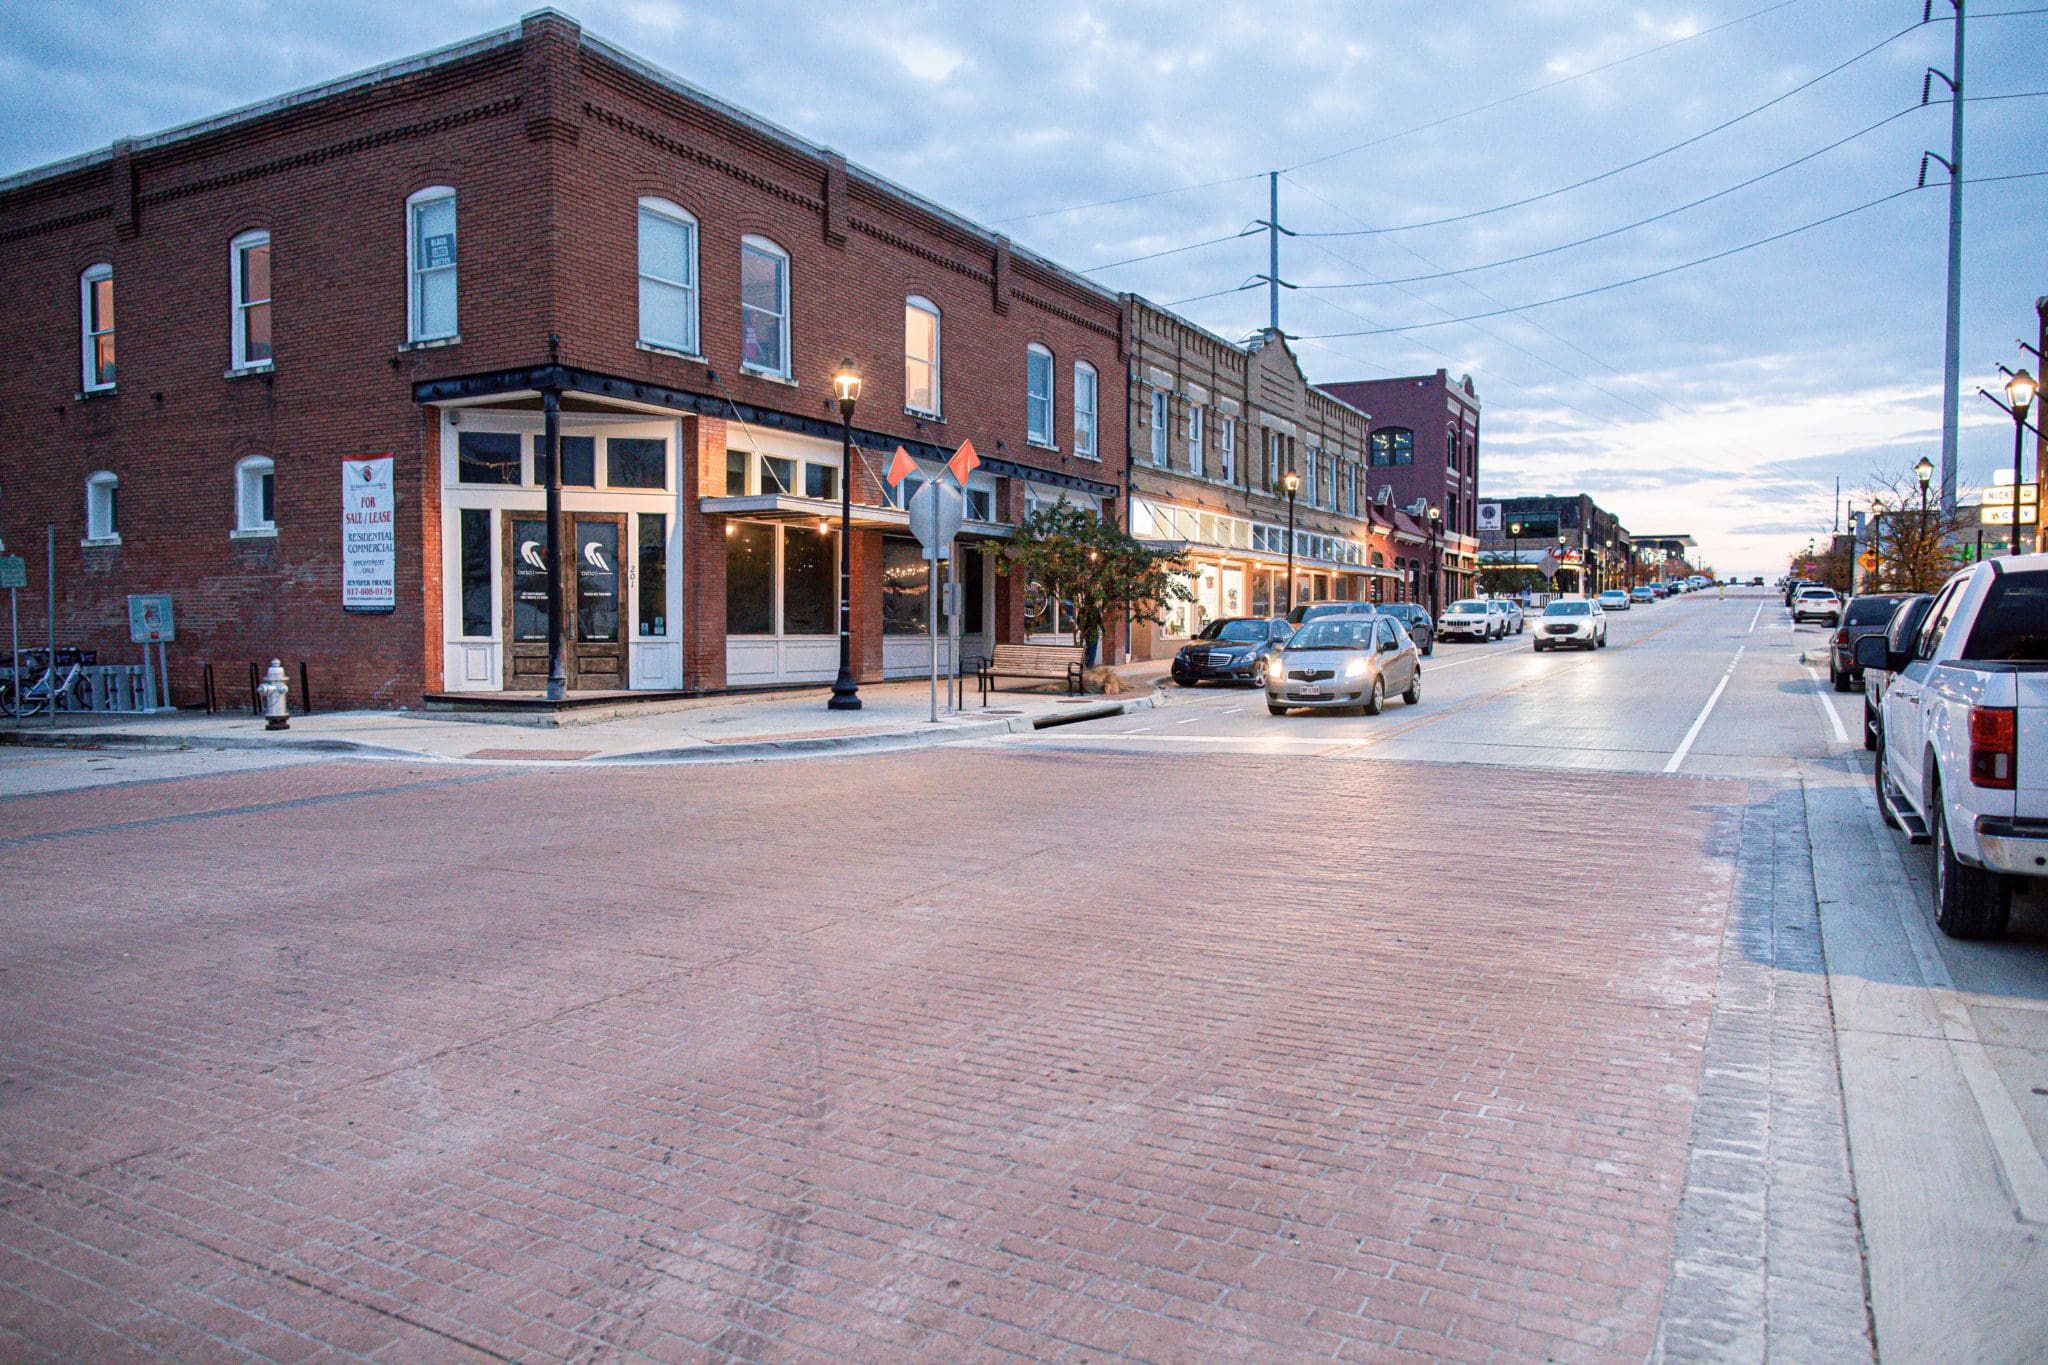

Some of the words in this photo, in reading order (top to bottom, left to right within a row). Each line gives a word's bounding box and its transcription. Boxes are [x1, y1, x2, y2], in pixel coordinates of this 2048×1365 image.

[361, 496, 376, 508] FOR
[348, 532, 393, 542] RESIDENTIAL
[347, 543, 394, 553] COMMERCIAL
